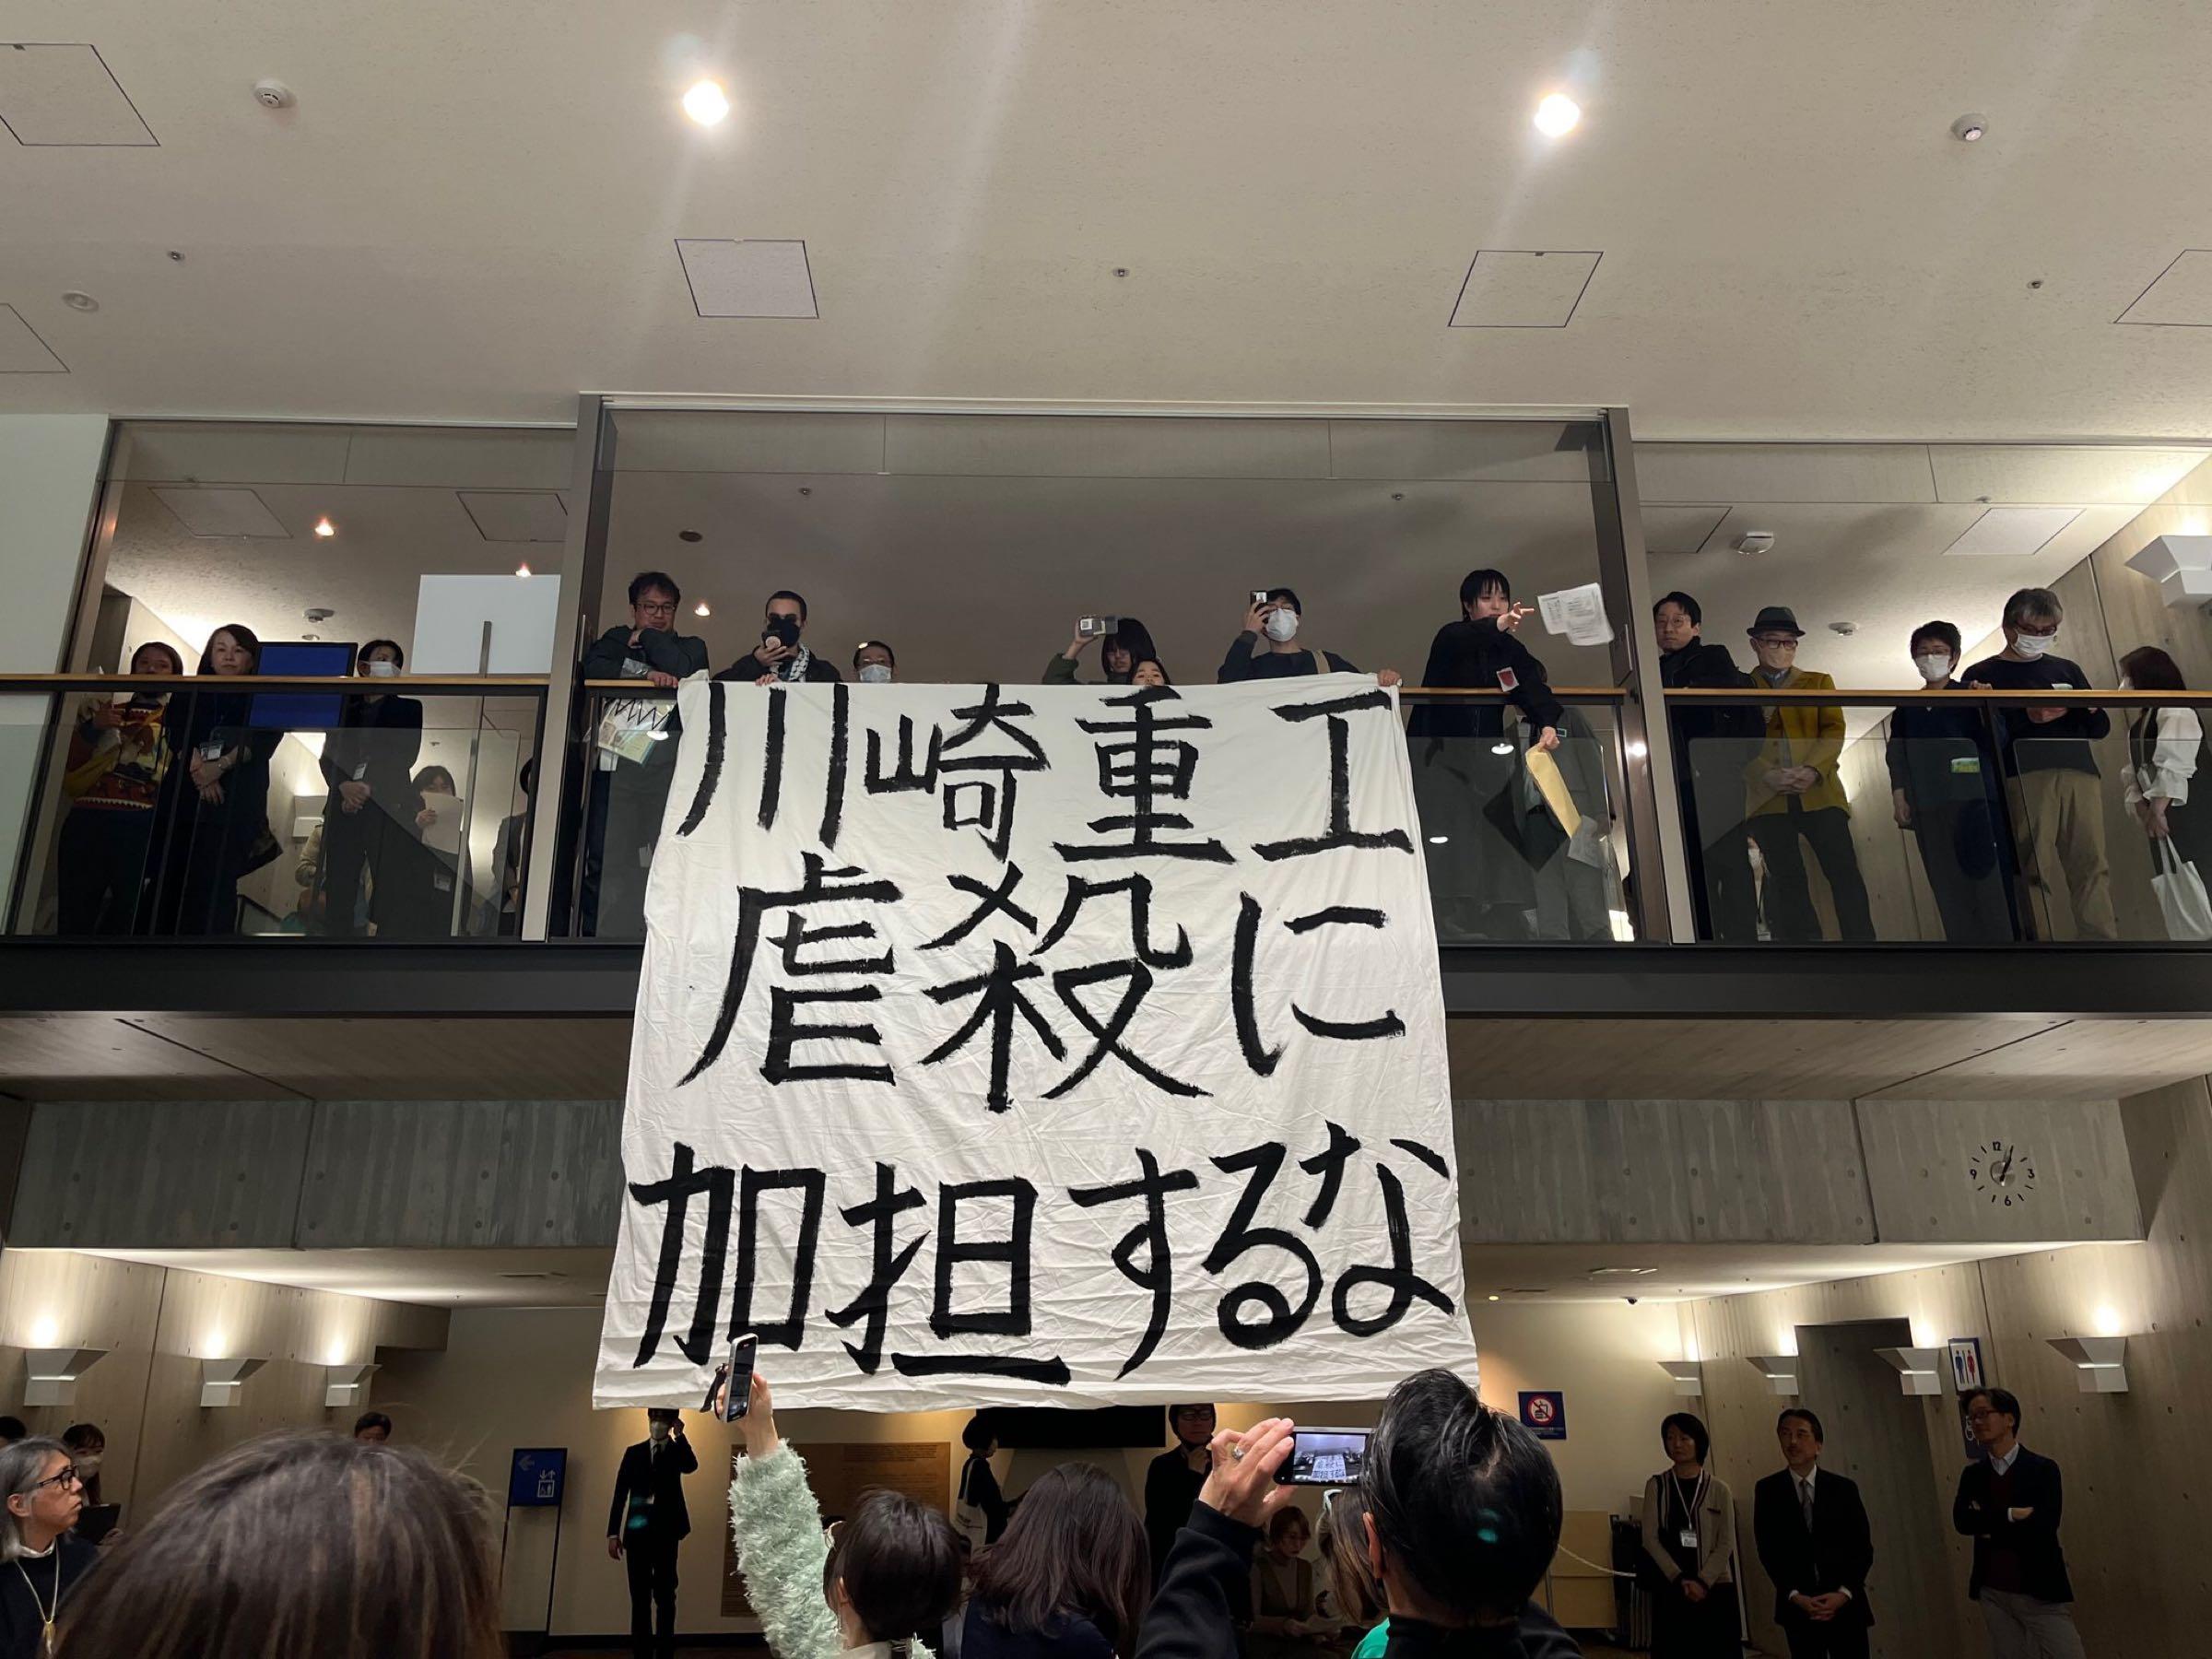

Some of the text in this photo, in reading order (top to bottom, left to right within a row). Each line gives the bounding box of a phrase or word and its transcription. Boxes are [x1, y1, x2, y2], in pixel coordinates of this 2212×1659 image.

[677, 683, 1414, 863] 川崎重工
[677, 852, 1406, 1113] 虐殺に
[1992, 1141, 2002, 1151] 12
[1970, 1169, 1977, 1180] 9
[2028, 1169, 2035, 1179] 3
[2004, 1195, 2011, 1206] 6
[629, 1119, 1454, 1385] 加担するな
